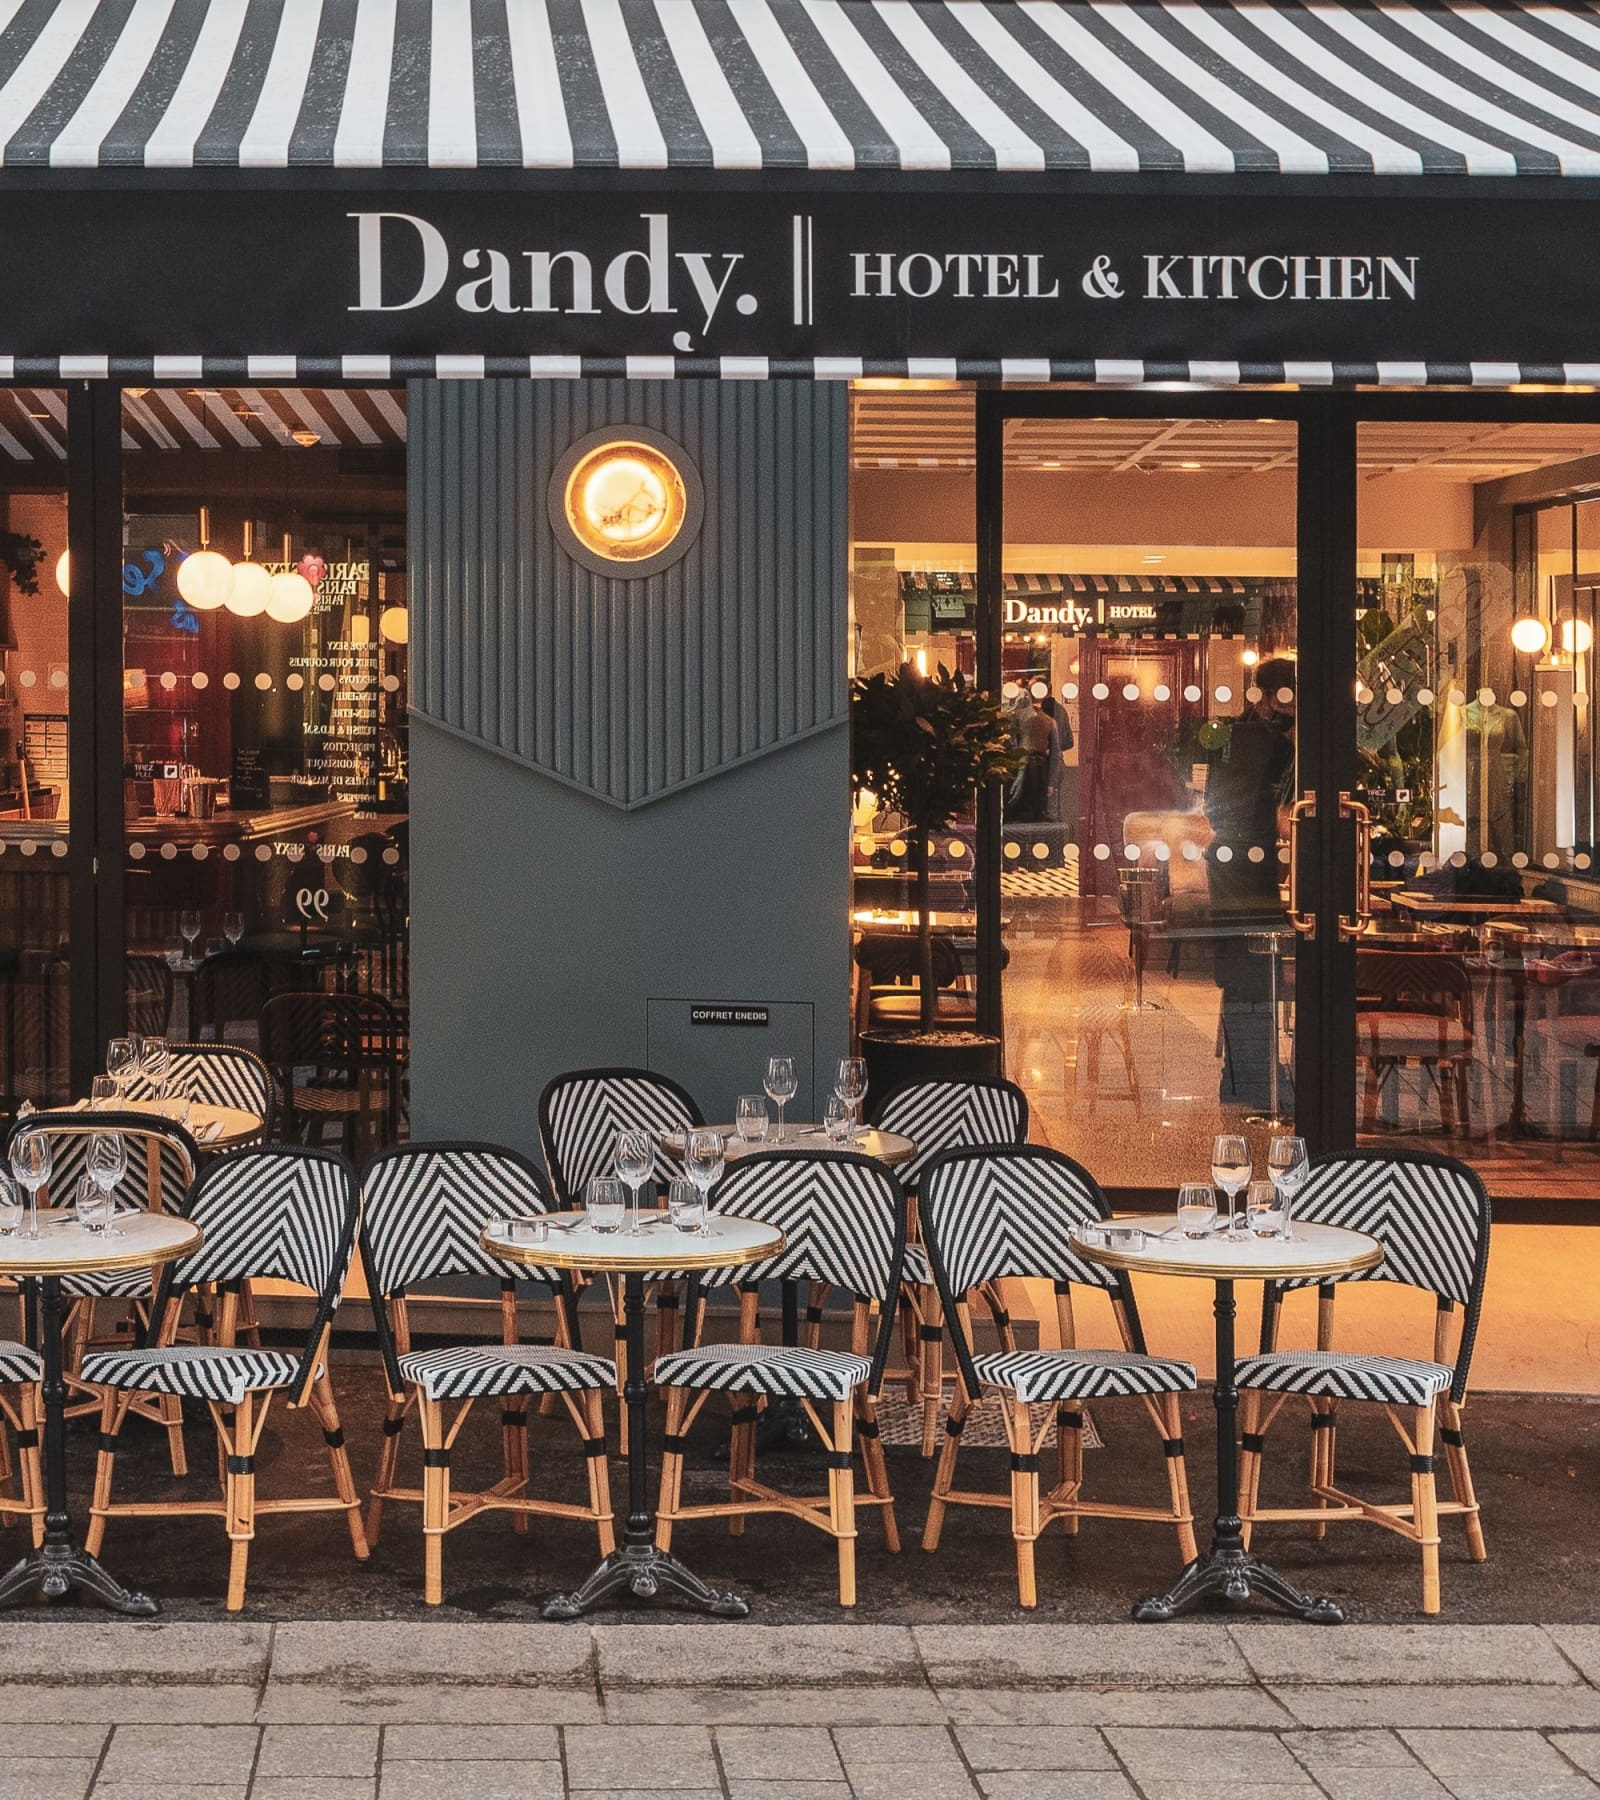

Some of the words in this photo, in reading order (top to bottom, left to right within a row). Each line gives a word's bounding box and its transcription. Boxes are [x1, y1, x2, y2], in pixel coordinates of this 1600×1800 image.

[344, 212, 760, 353] Dandy.
[847, 252, 1059, 301] HOTEL
[1081, 253, 1124, 299] &
[1141, 253, 1421, 303] KITCHEN
[1003, 599, 1093, 631] Dandy.
[1110, 605, 1157, 618] HOTEL
[692, 1010, 733, 1020] COFFRET
[735, 1011, 767, 1020] ENEDIS
